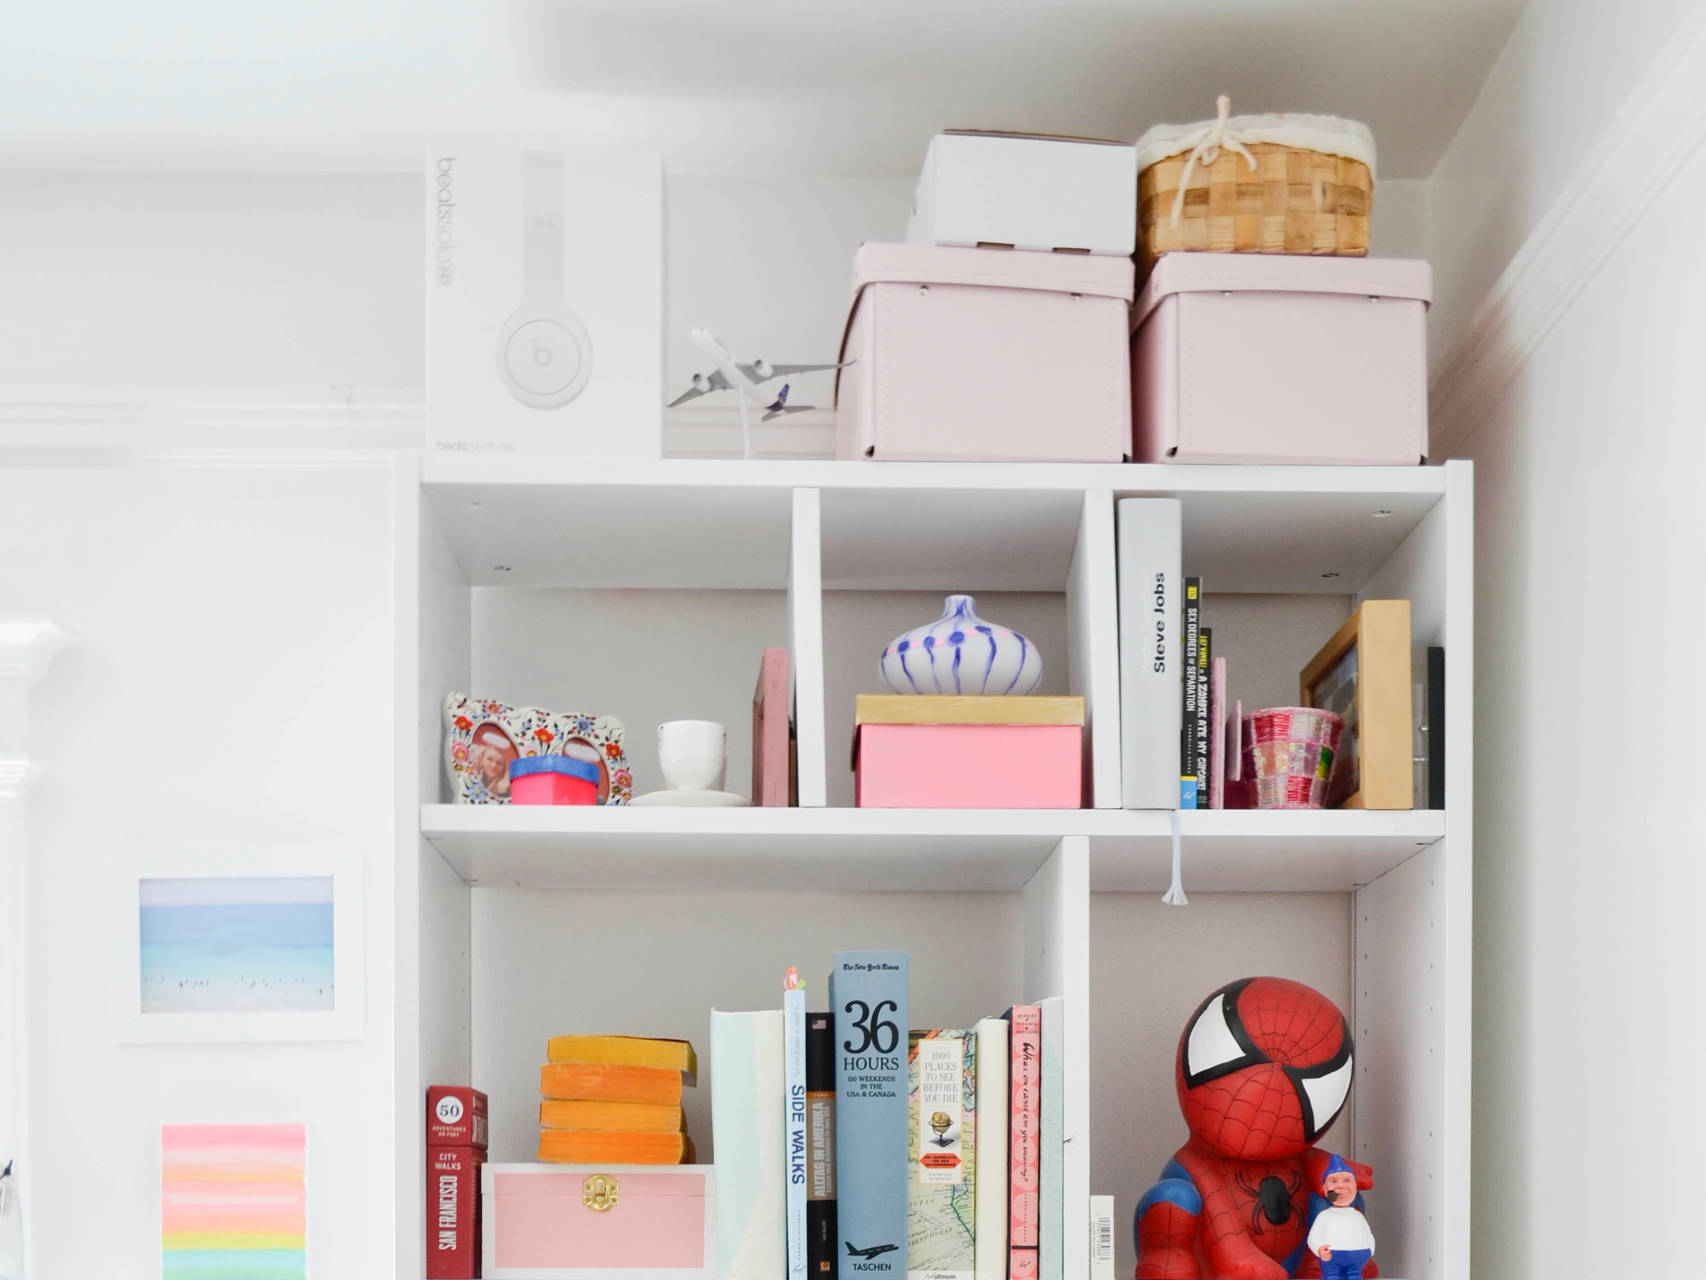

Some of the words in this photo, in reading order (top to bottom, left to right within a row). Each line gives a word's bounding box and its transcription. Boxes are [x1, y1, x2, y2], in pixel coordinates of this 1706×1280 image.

[1153, 572, 1166, 615] Jobs
[1188, 608, 1197, 623] SEX
[1153, 620, 1166, 674] Steve
[1187, 624, 1197, 657] DEGREES
[1186, 666, 1196, 712] SEPARATION
[1198, 720, 1208, 739] ATE
[1198, 741, 1207, 754] MY
[843, 1000, 900, 1054] 36
[932, 1051, 951, 1060] 1000
[843, 1057, 900, 1071] HOURS
[924, 1062, 957, 1071] PLACES
[925, 1073, 937, 1081] TO
[938, 1073, 956, 1081] SEE
[923, 1083, 958, 1092] BEFORE
[440, 1104, 460, 1117] 50
[792, 1085, 805, 1122] SIDE
[811, 1102, 825, 1147] AMERIKA
[439, 1152, 457, 1161] CITY
[792, 1129, 805, 1185] WALKS
[813, 1149, 825, 1160] IN
[435, 1161, 461, 1170] WALKS
[439, 1175, 457, 1228] FRANCISCO
[438, 1231, 457, 1250] SAN
[852, 1263, 892, 1272] TASCHEN
